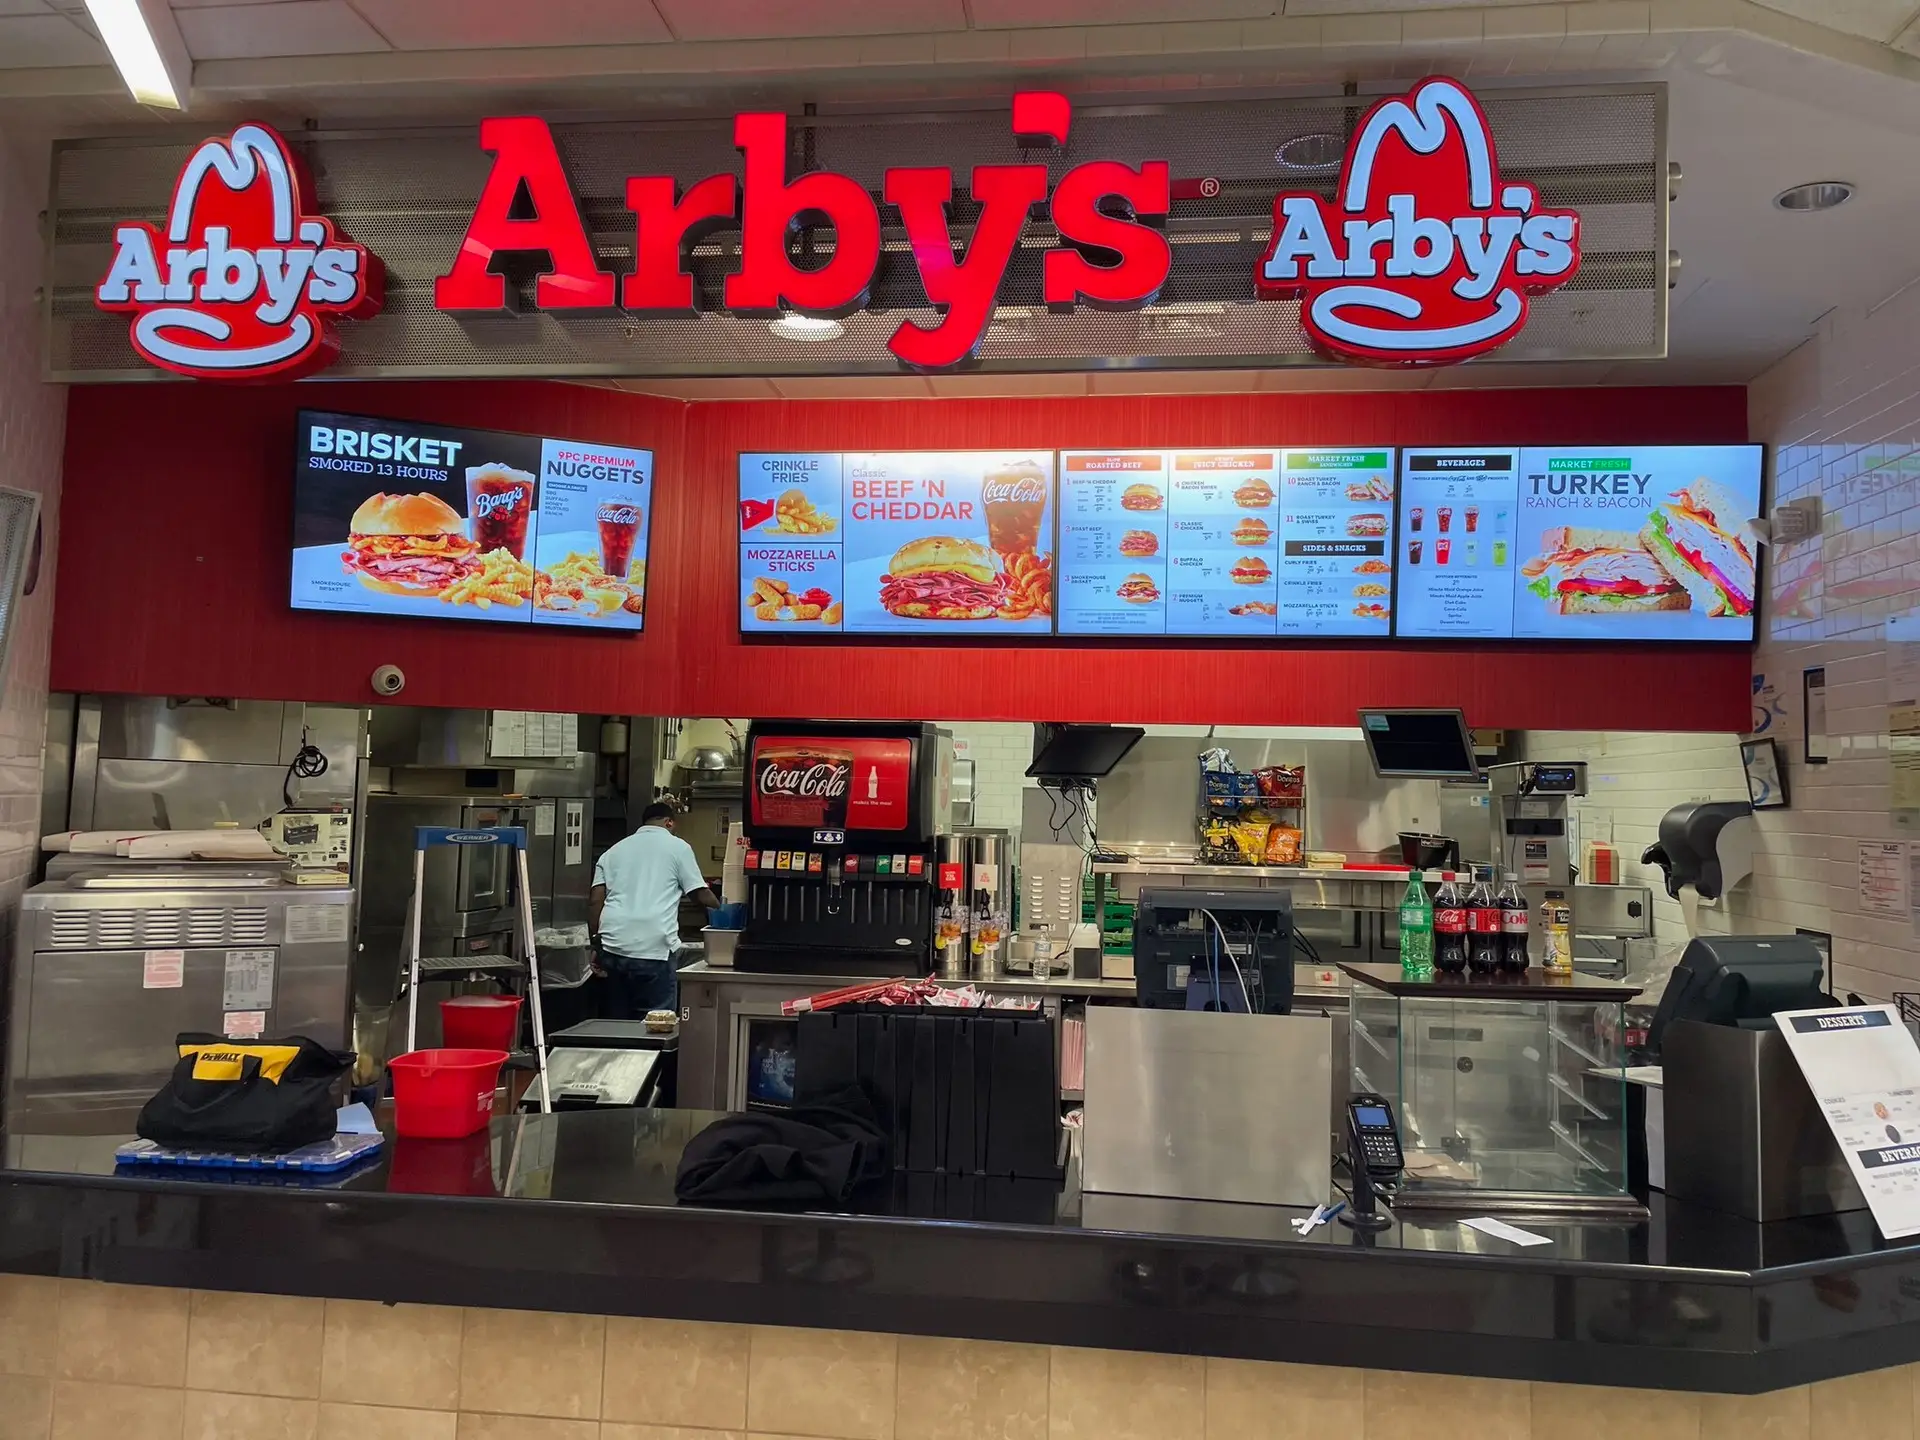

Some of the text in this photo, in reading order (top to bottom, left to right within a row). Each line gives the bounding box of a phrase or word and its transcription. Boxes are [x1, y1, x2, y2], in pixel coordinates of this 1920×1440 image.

[434, 91, 1171, 366] Arby's
[1265, 187, 1574, 299] Arby's
[99, 223, 358, 324] Arby's
[310, 426, 462, 466] BRISKET
[558, 451, 635, 468] 9PC PREMIUM
[762, 460, 818, 471] CRINKLE
[1436, 459, 1486, 467] BEVERAGES
[1550, 460, 1628, 468] MARKET FRESH
[309, 456, 448, 481] SMOKED 13 HOURS
[547, 460, 644, 485] NUGGETS
[852, 468, 886, 478] Classic
[772, 472, 809, 483] FRIES
[1287, 477, 1296, 485] 10
[1528, 473, 1652, 495] TURKEY
[852, 480, 914, 498] BEEF
[983, 477, 1044, 505] Coca-Cola
[475, 487, 523, 517] Barq's
[852, 501, 974, 520] CHEDDAR
[1526, 496, 1652, 508] RANCH & BACON
[597, 507, 638, 525] Coca-Cola
[1286, 515, 1294, 523] 11
[747, 549, 836, 560] MOZZARELLA
[1334, 544, 1367, 552] SNACKS
[768, 561, 815, 572] STICKS
[760, 763, 849, 797] Coca-Cola
[1277, 774, 1301, 784] Doritos
[1816, 1015, 1867, 1029] DESSERTS
